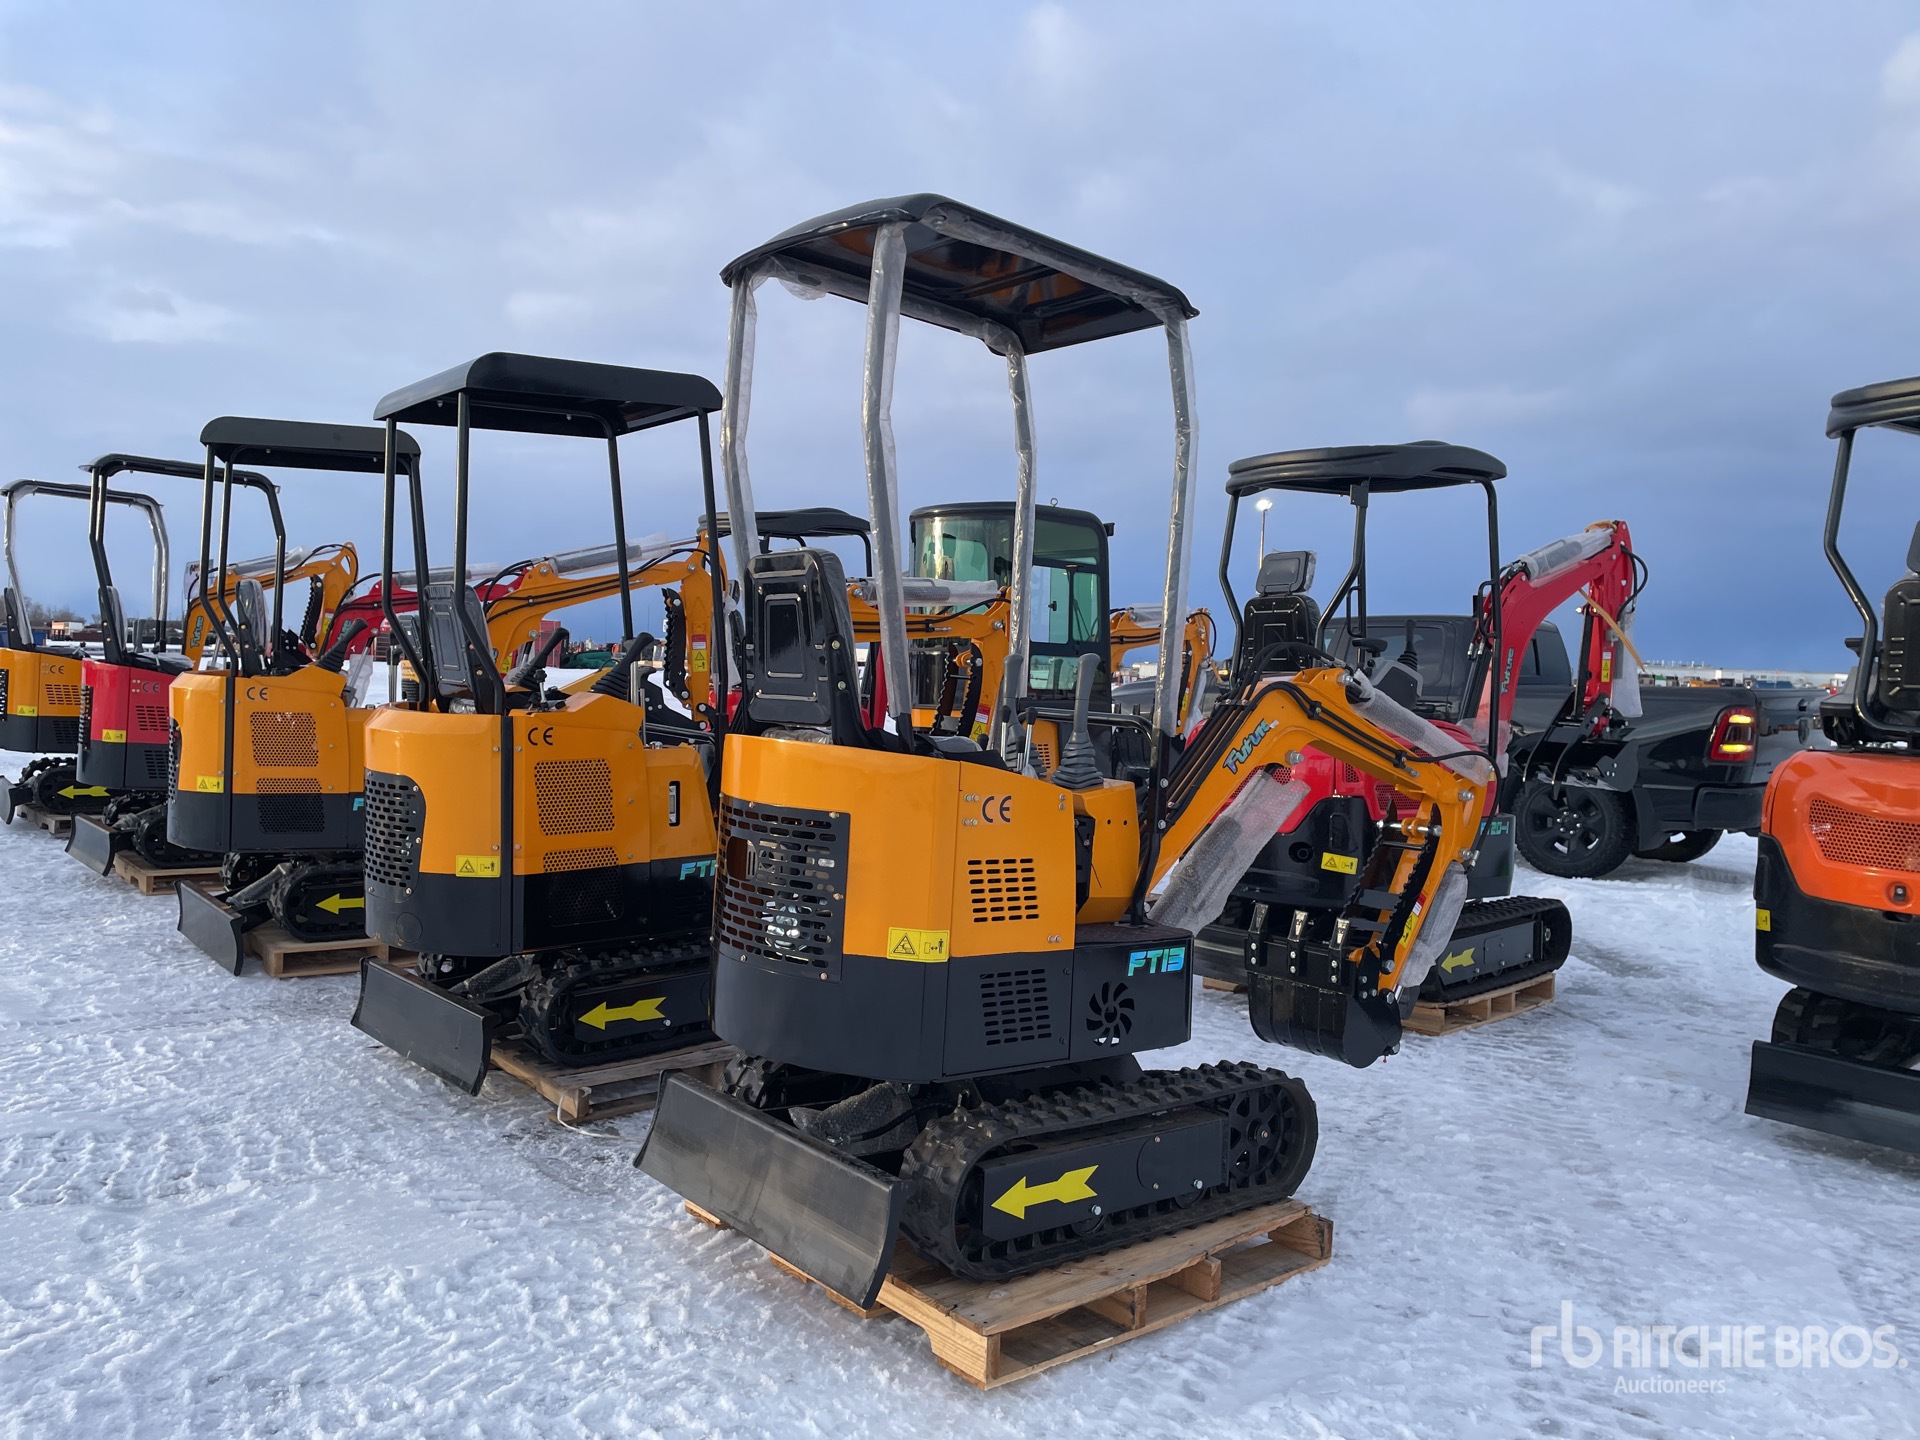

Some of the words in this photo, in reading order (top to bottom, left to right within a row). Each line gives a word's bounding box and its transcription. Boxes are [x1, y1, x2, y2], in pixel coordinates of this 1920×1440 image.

[50, 665, 65, 675] CE
[142, 681, 160, 693] CE
[246, 686, 269, 701] CE
[527, 726, 554, 746] CE
[1222, 717, 1271, 775] Future
[981, 795, 1012, 823] CE
